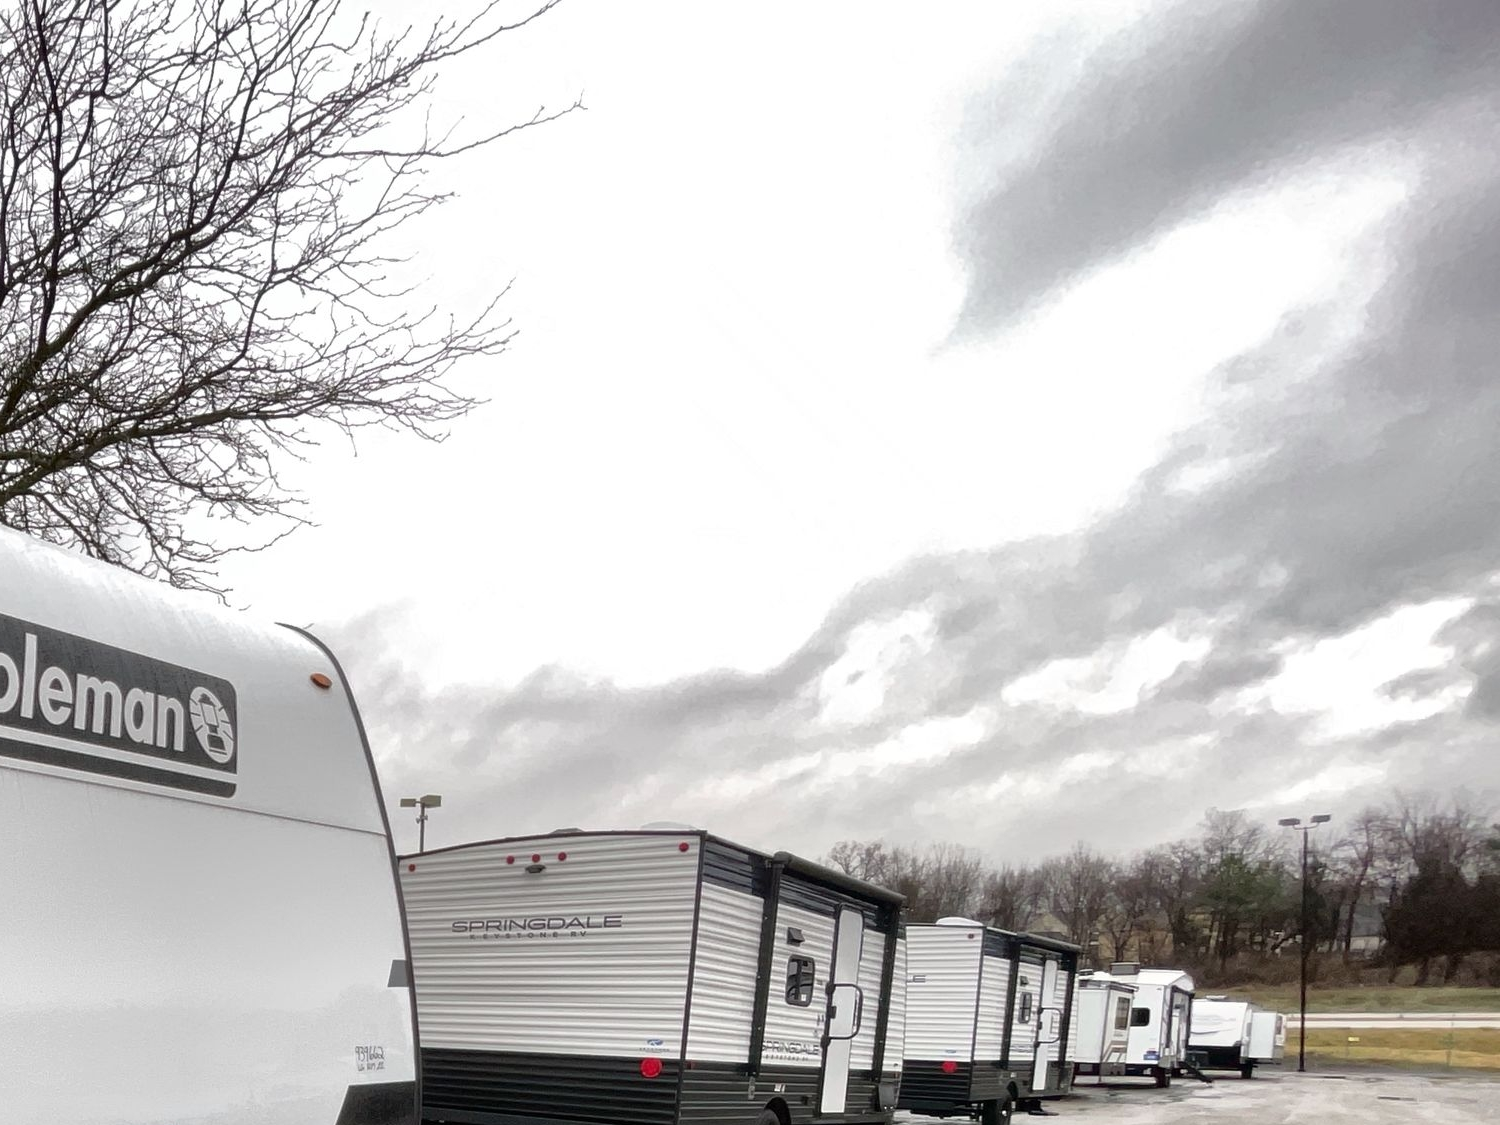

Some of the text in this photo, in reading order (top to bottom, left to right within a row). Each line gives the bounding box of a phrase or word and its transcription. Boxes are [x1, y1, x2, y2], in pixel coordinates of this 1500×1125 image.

[451, 915, 623, 933] SPRINGDALE
[469, 930, 587, 940] KEYSTONE RV
